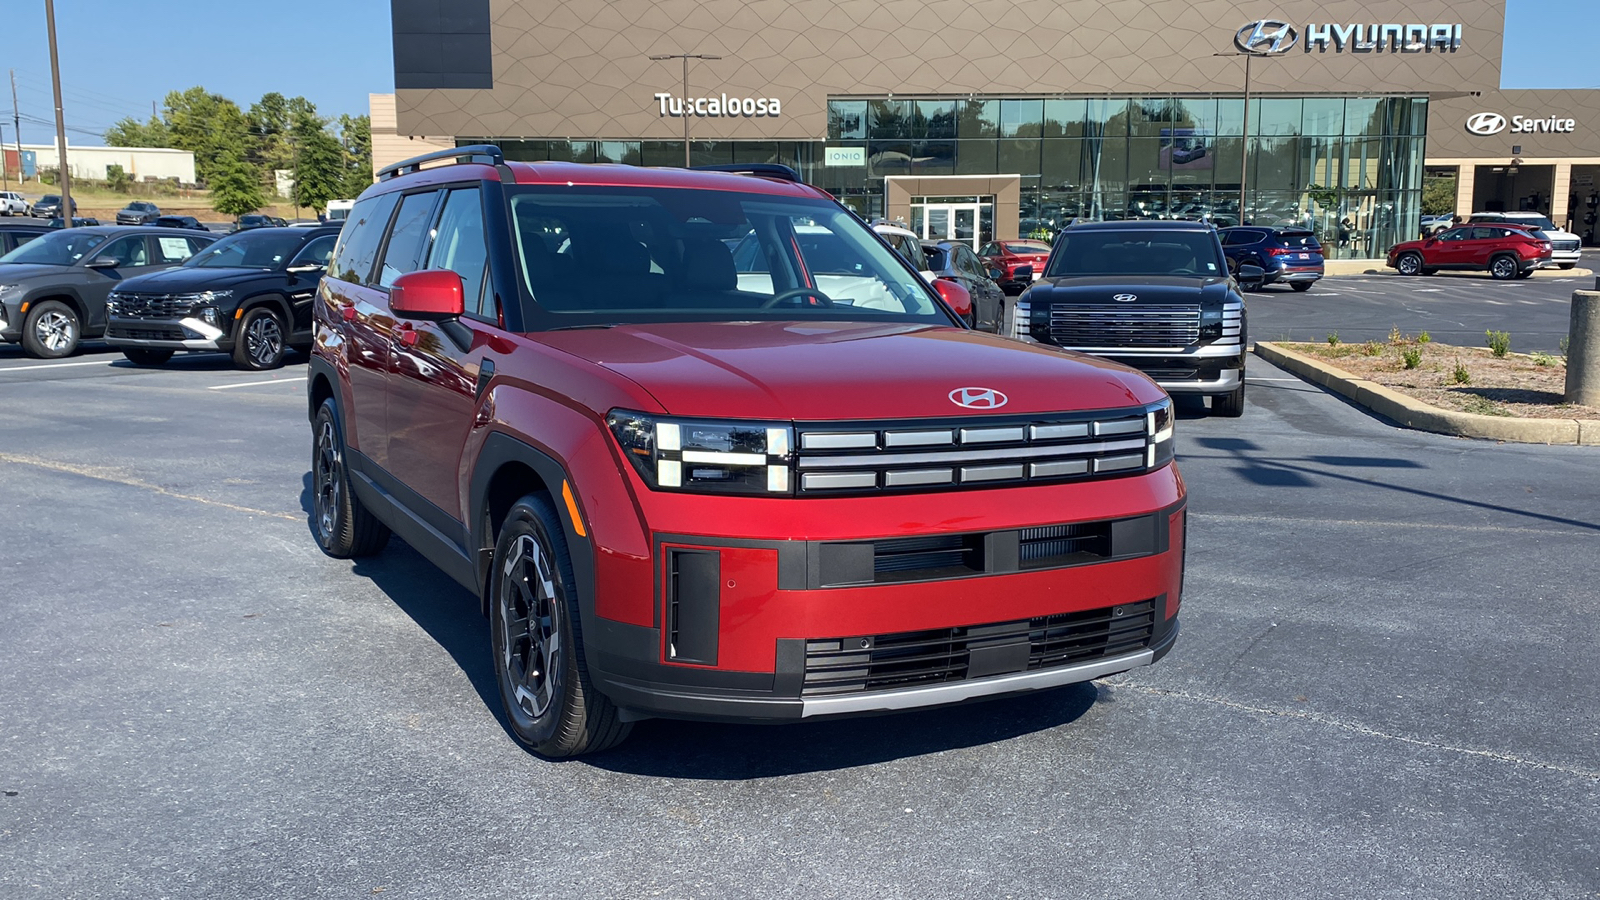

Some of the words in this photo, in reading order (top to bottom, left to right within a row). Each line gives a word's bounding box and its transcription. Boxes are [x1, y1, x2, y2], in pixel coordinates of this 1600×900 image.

[1306, 23, 1462, 53] HYUNDAI
[654, 92, 781, 116] Tuscaloosa
[1511, 115, 1576, 133] Service
